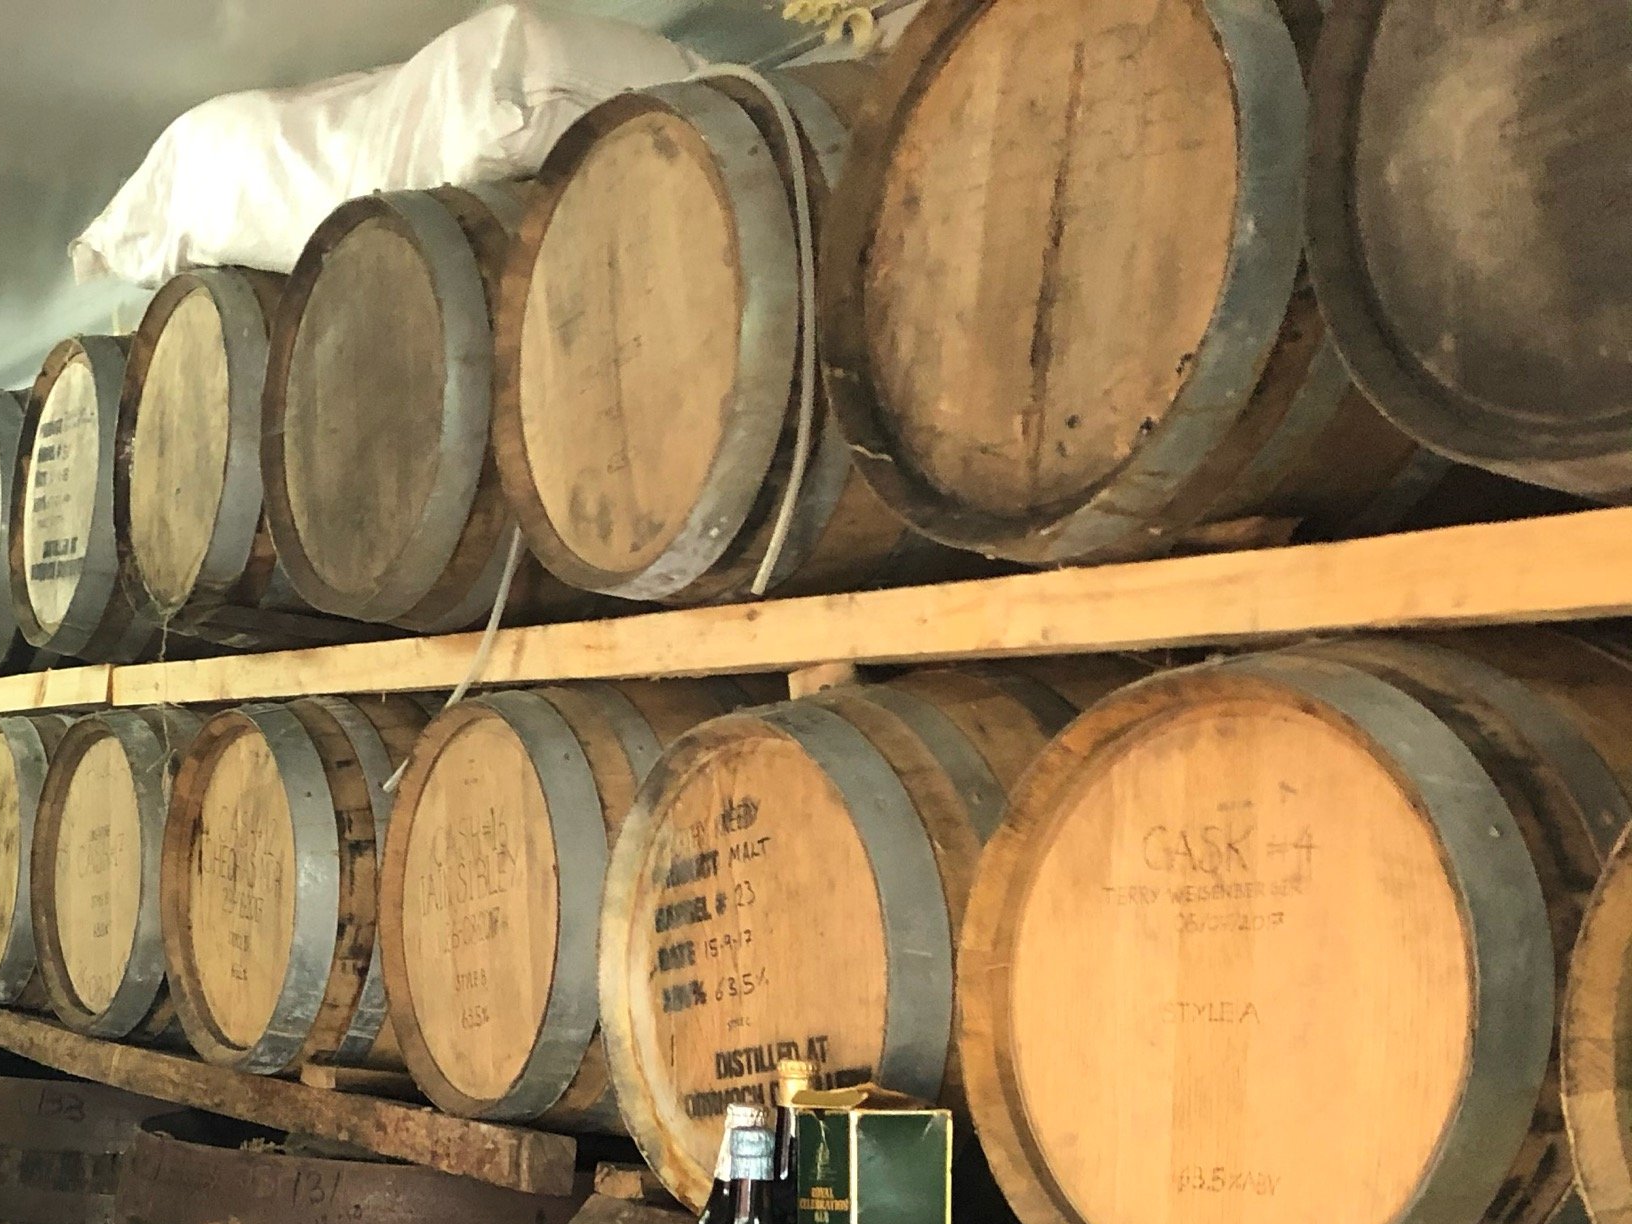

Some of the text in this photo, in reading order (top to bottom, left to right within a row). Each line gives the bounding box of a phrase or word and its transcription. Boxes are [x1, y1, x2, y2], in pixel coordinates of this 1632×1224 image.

[728, 836, 771, 868] MALT
[1142, 821, 1257, 875] CASK
[715, 1034, 829, 1079] DISTILLED AT
[291, 1170, 341, 1207] 131
